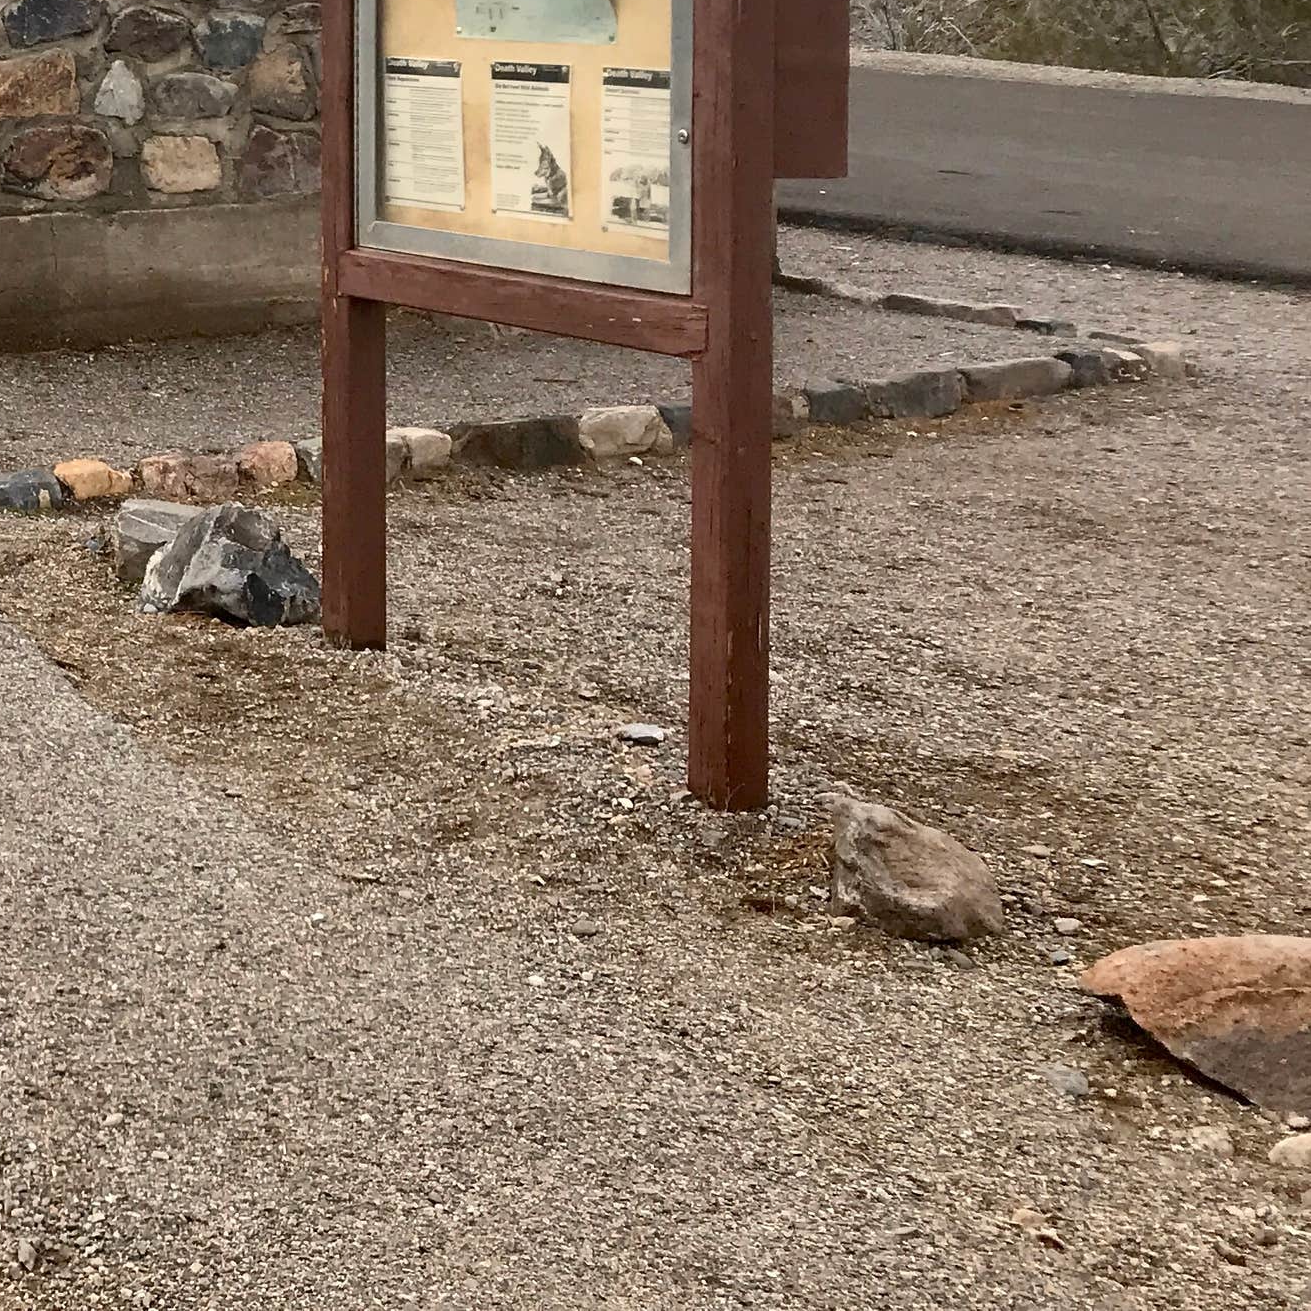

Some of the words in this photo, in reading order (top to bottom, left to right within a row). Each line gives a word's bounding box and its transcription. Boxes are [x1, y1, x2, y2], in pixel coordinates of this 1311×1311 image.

[494, 63, 515, 73] Death
[516, 64, 537, 76] Valley
[629, 70, 653, 82] Valley
